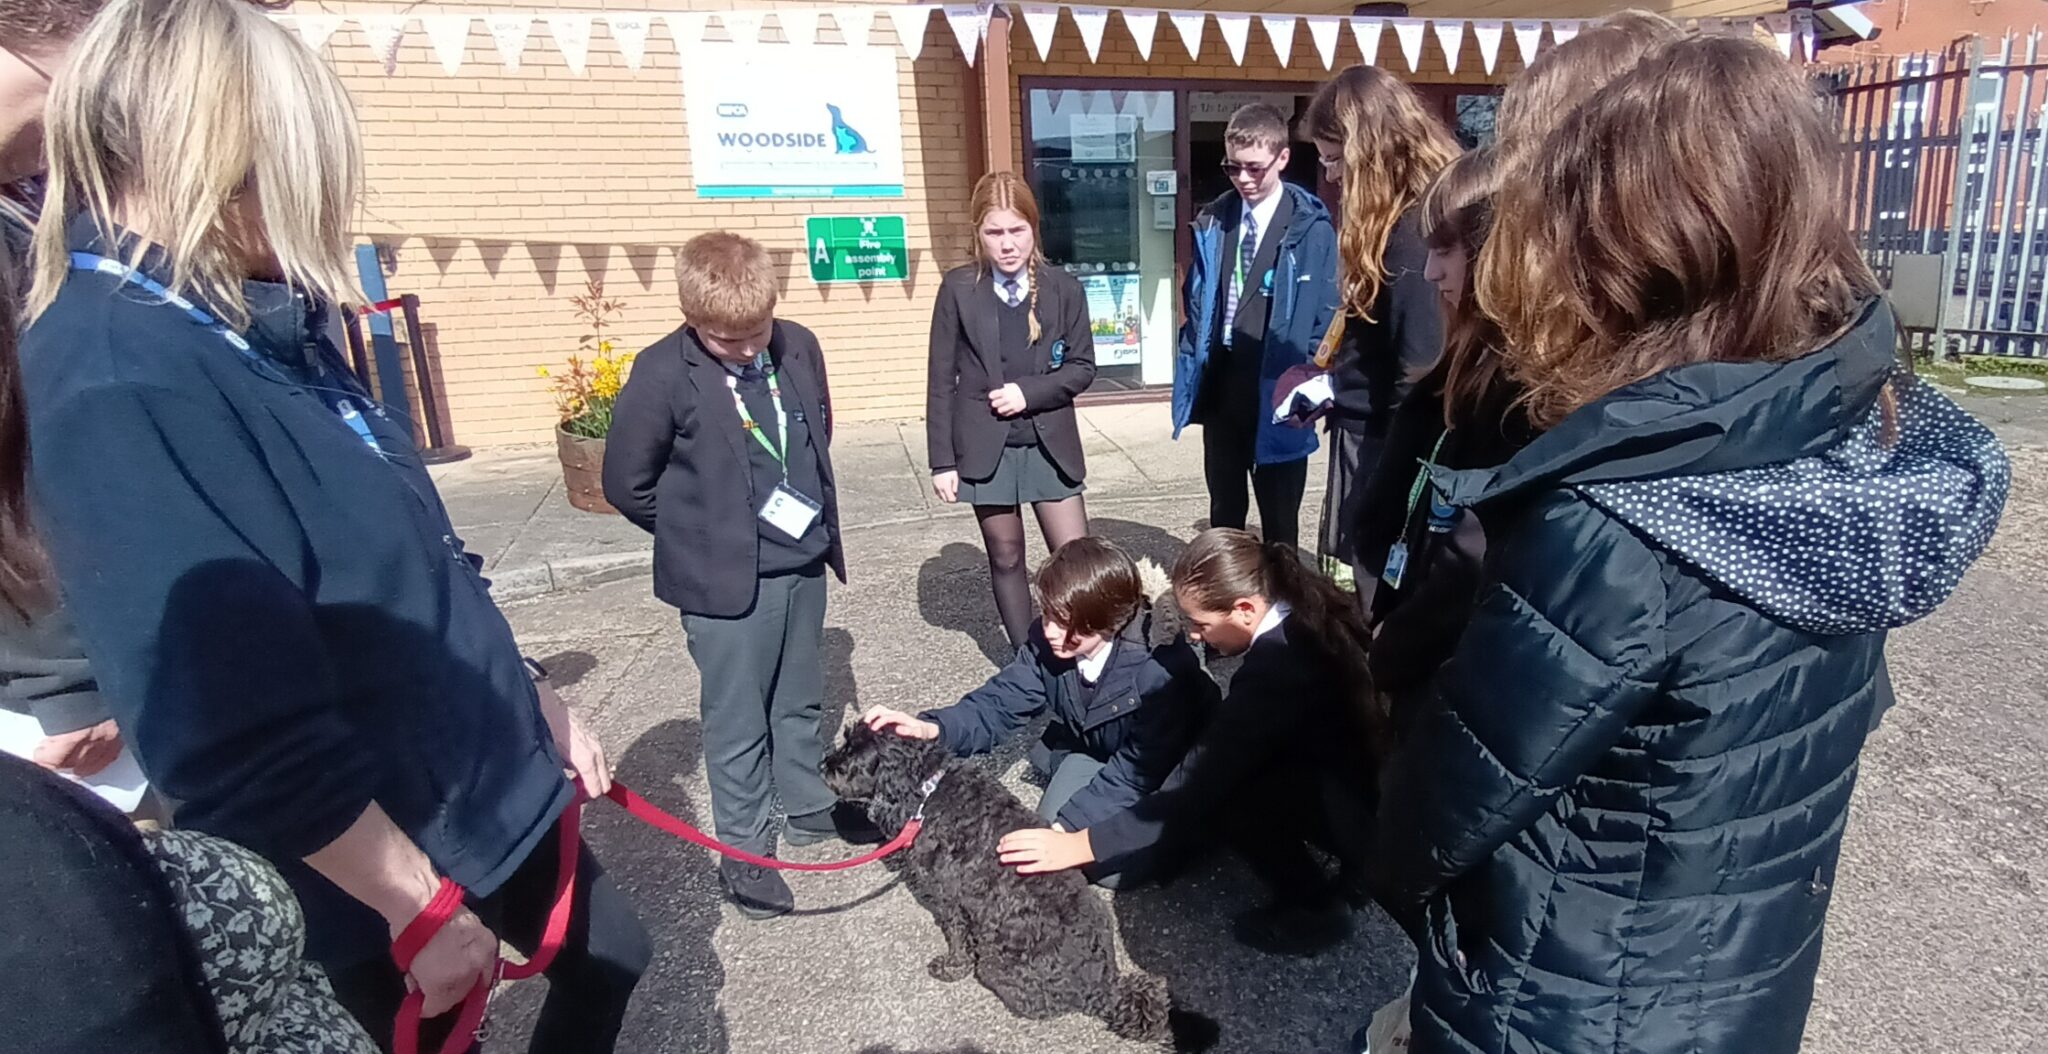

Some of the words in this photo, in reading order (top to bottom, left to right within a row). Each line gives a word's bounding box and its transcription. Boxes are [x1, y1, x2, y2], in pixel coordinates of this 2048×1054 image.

[717, 132, 827, 148] WOODSIDE
[814, 237, 831, 264] A
[859, 239, 881, 249] Fire
[844, 252, 896, 265] assembly
[858, 266, 887, 278] point
